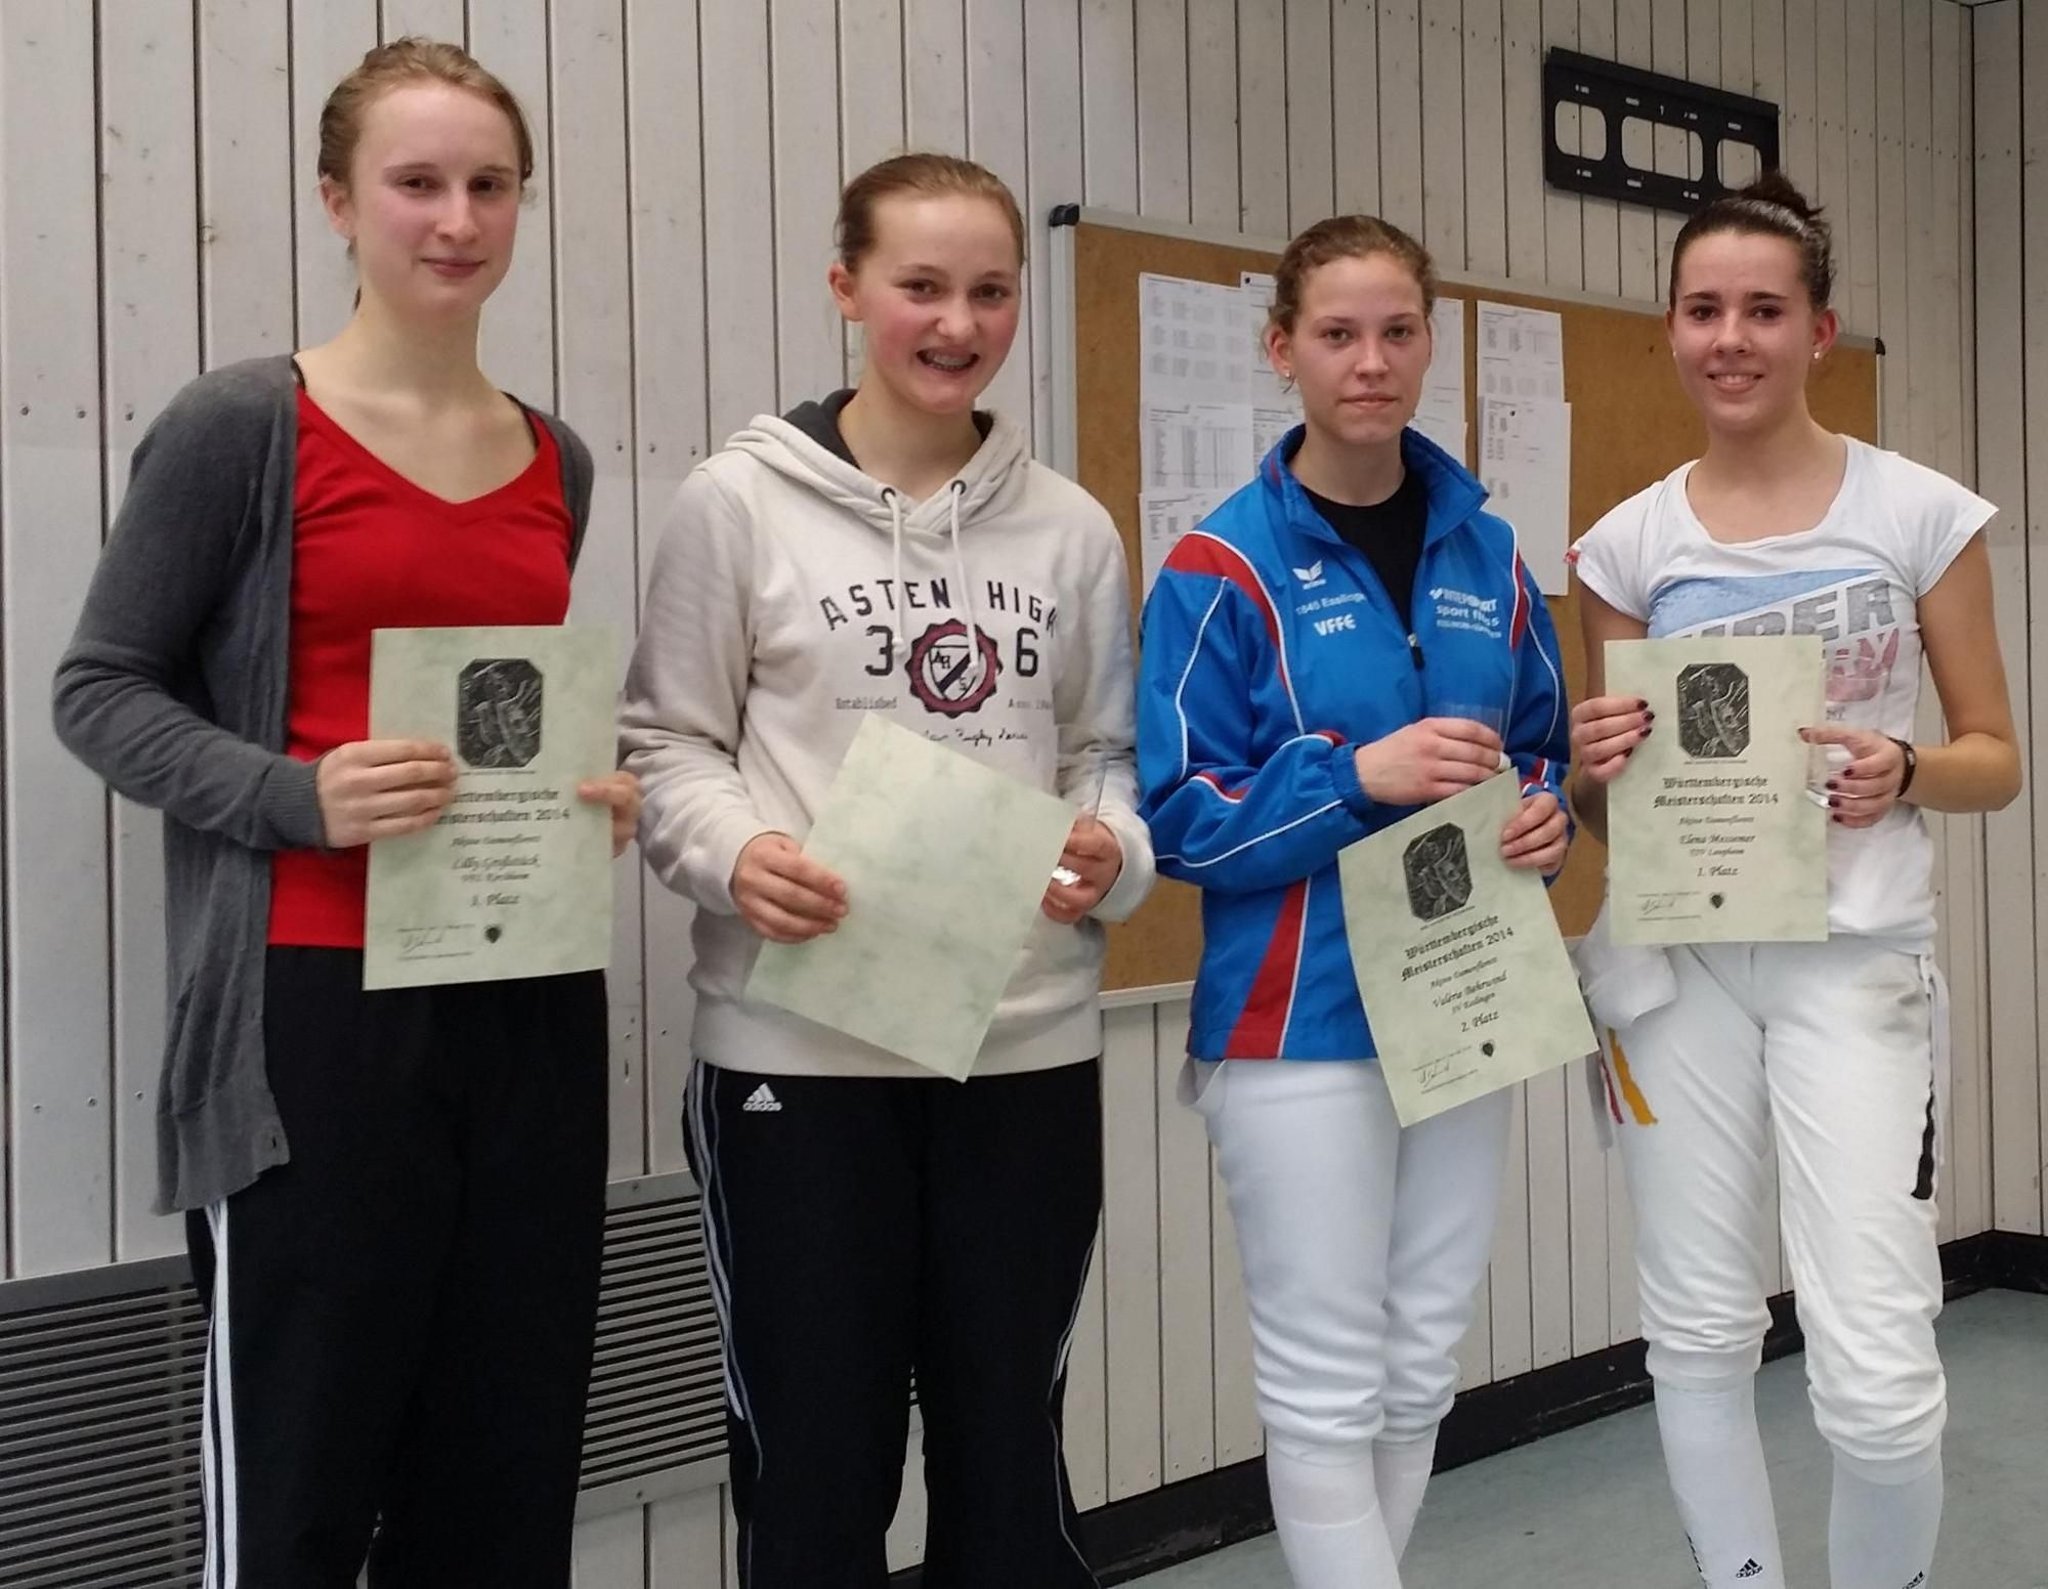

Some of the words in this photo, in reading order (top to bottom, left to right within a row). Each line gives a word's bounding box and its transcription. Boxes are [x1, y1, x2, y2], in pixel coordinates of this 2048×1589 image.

[820, 577, 952, 631] ASTEN
[1313, 613, 1357, 636] VFFE
[864, 625, 893, 676] 3
[1016, 627, 1039, 677] 6
[1747, 793, 1779, 805] 2014
[536, 807, 570, 821] 2014
[1709, 865, 1739, 877] Platz
[1485, 926, 1515, 946] 2014
[1472, 1010, 1500, 1028] Platz
